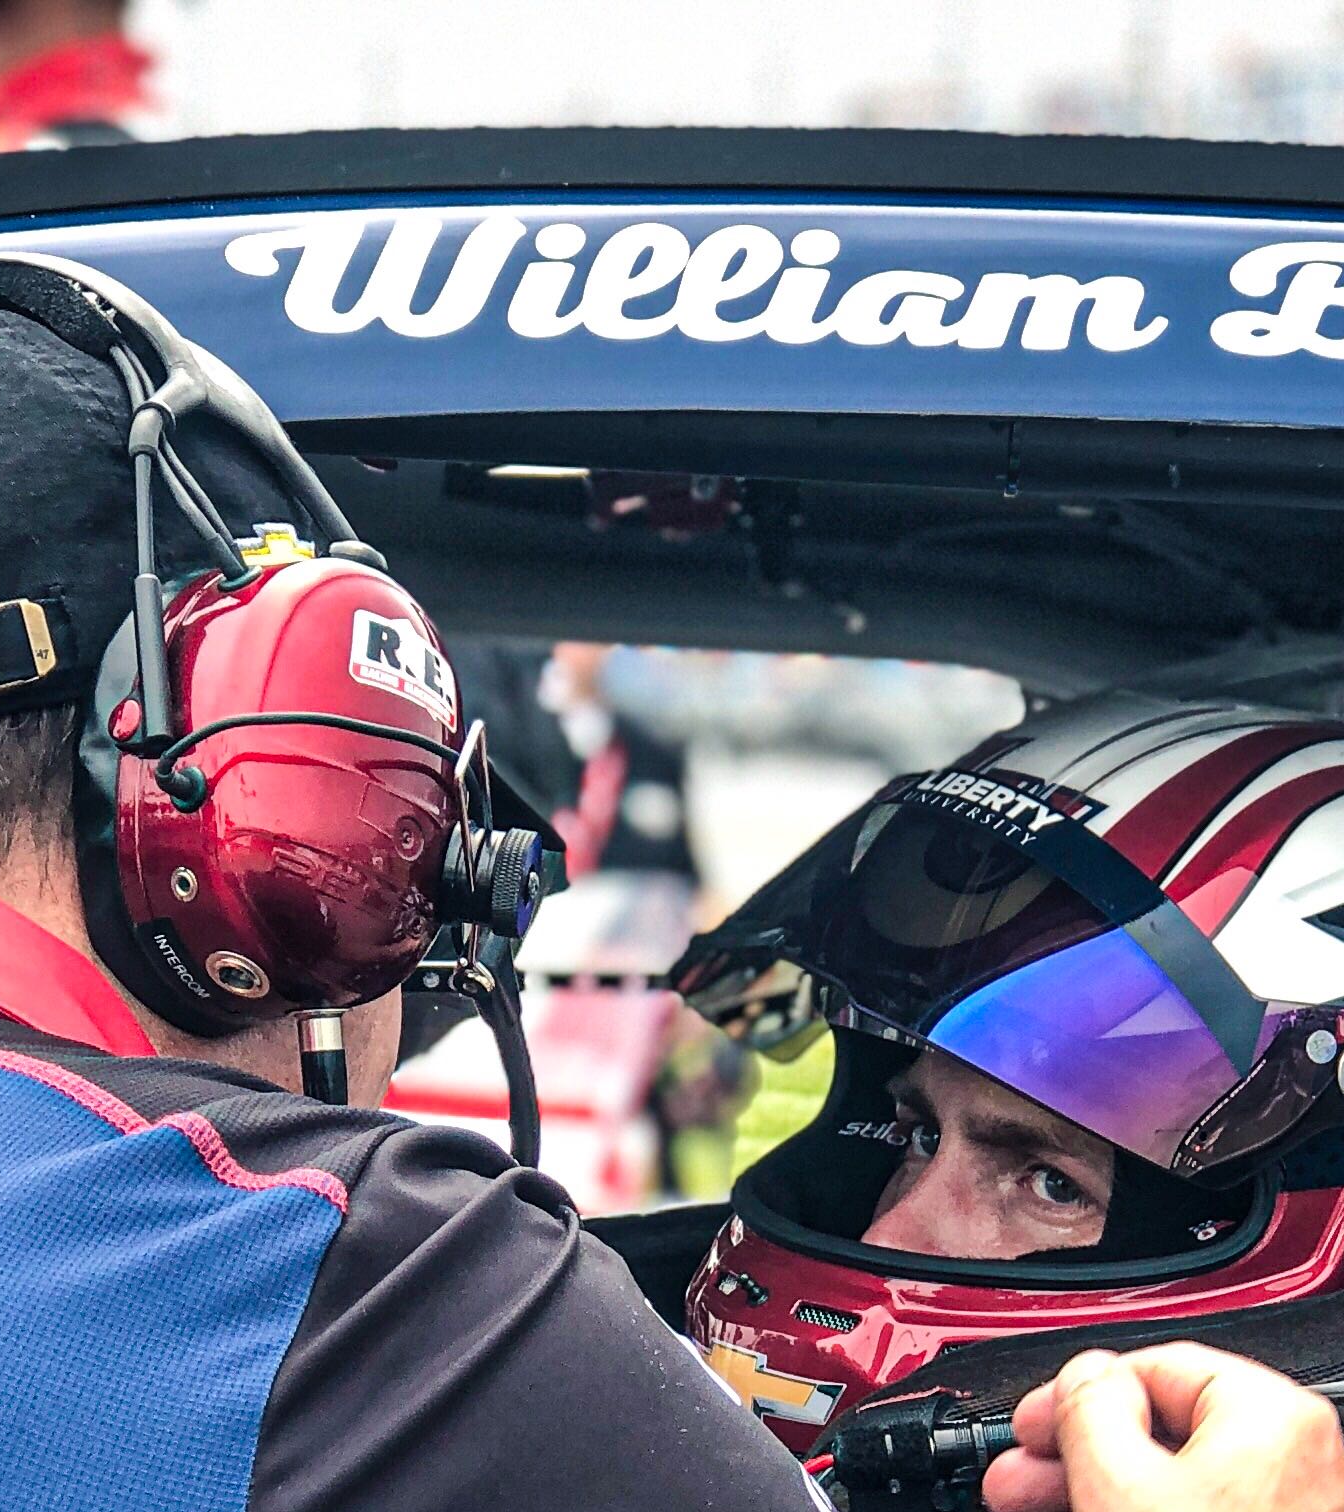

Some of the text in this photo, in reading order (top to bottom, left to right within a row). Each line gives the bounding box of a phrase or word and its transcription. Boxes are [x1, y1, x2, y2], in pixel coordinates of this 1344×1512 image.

[224, 214, 1168, 354] William
[903, 790, 1037, 846] UNIVERSITY
[916, 771, 1065, 832] LIBERTY
[153, 934, 211, 998] INTERCOM
